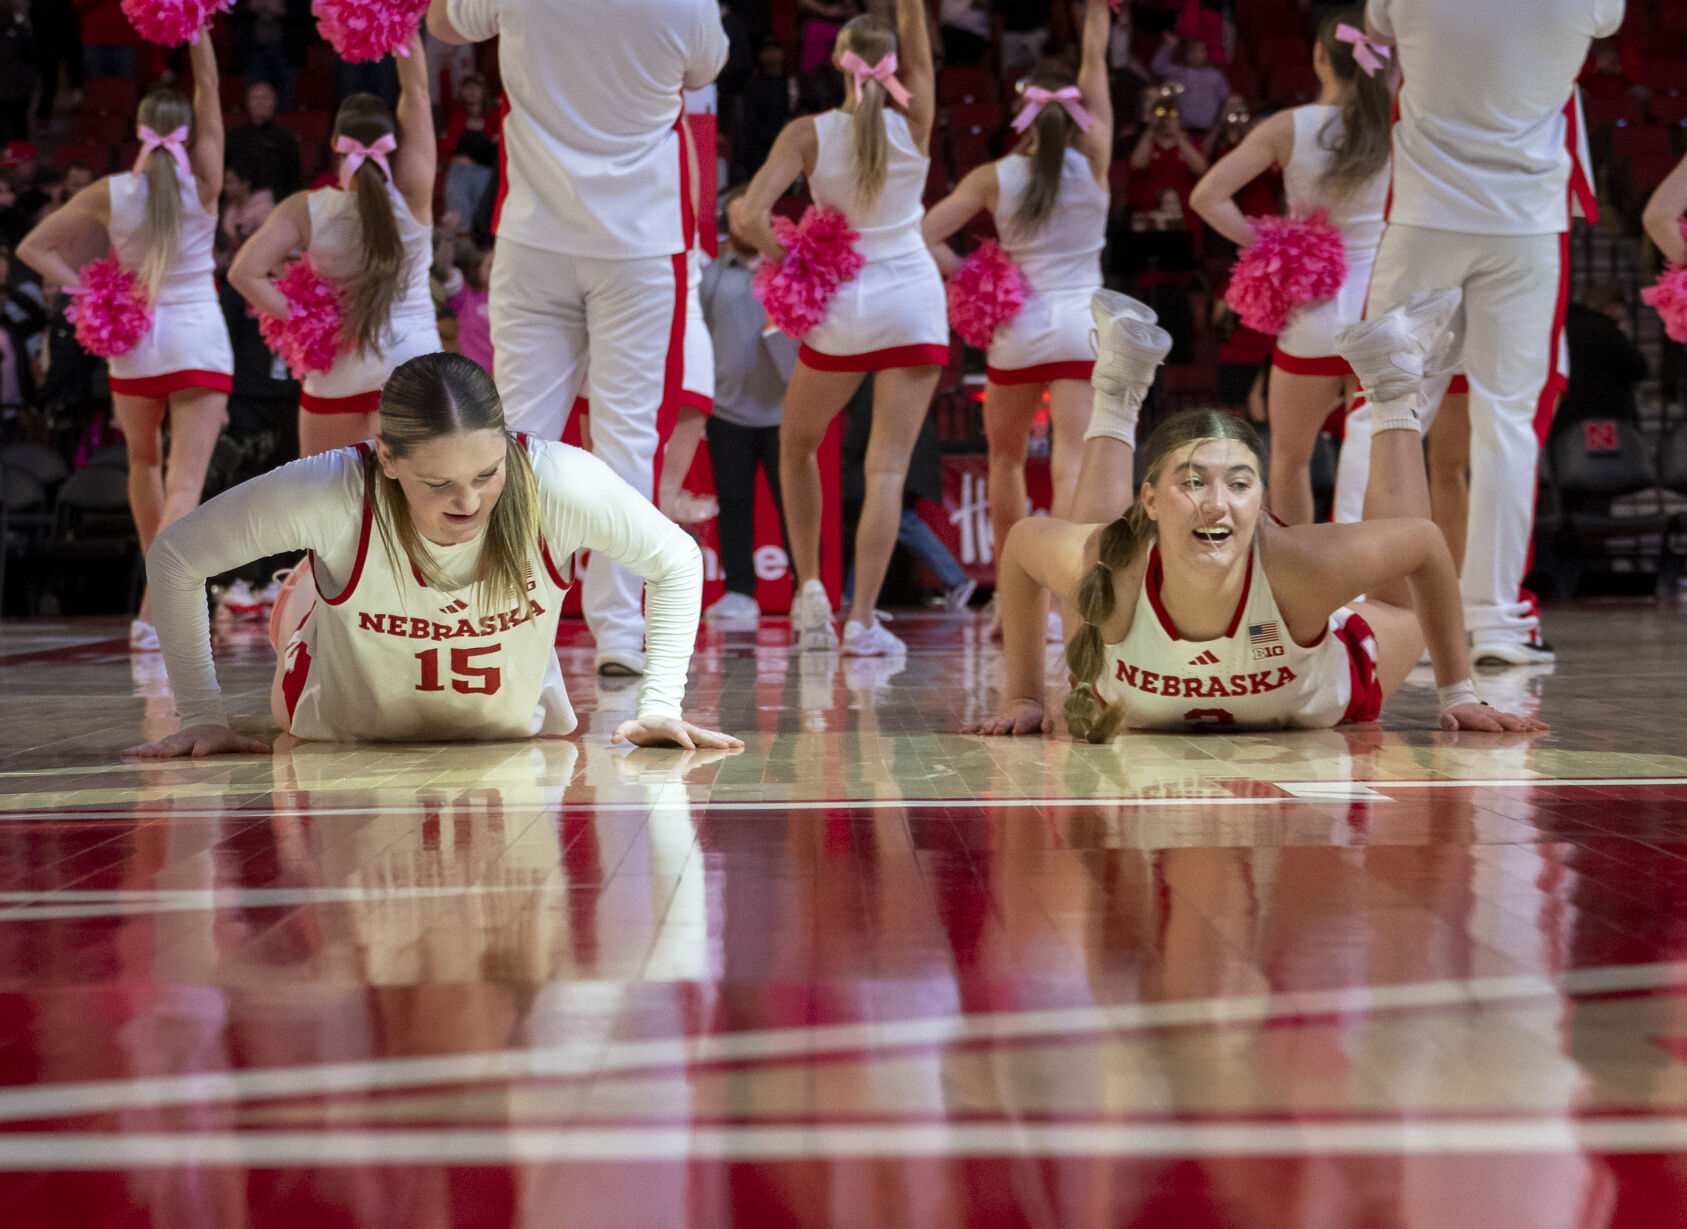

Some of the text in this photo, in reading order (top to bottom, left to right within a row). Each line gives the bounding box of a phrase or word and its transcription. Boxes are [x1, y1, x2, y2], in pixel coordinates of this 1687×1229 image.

[358, 599, 546, 641] NEBRASKA
[415, 642, 502, 696] 15
[1115, 658, 1297, 698] NEBRASKA
